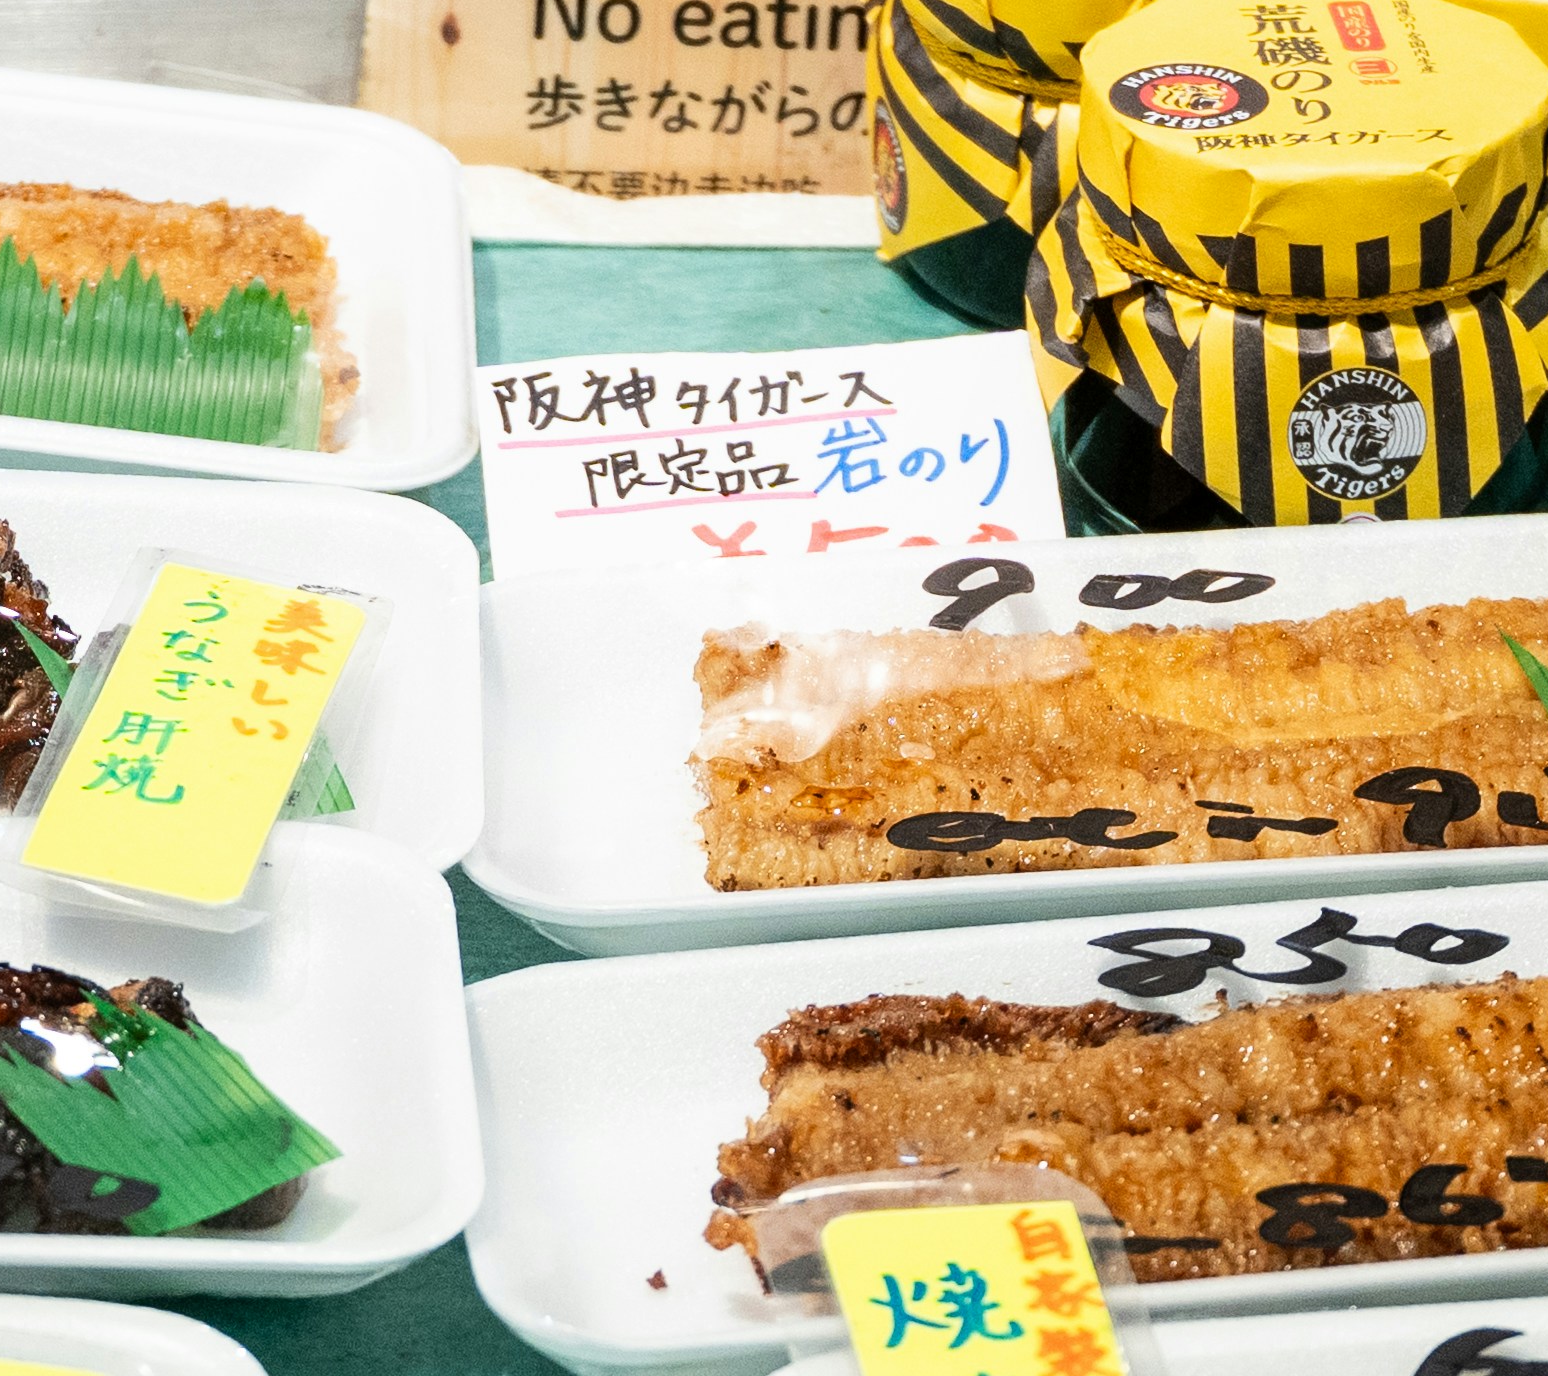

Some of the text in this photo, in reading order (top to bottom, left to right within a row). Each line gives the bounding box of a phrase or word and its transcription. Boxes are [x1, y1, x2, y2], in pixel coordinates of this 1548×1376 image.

[1122, 64, 1243, 89] HANSHIN
[1240, 4, 1333, 125] 荒磯のり
[1141, 108, 1251, 130] Tigers
[1195, 128, 1453, 153] 阪神タイガース
[491, 366, 894, 434] 阪神タイガース
[1300, 370, 1409, 410] HANSHIN
[583, 417, 1010, 508] 限定品 岩のり
[1315, 464, 1405, 499] Tigers
[920, 558, 1275, 630] 900
[232, 599, 334, 741] 美味しい
[1089, 907, 1514, 998] 850
